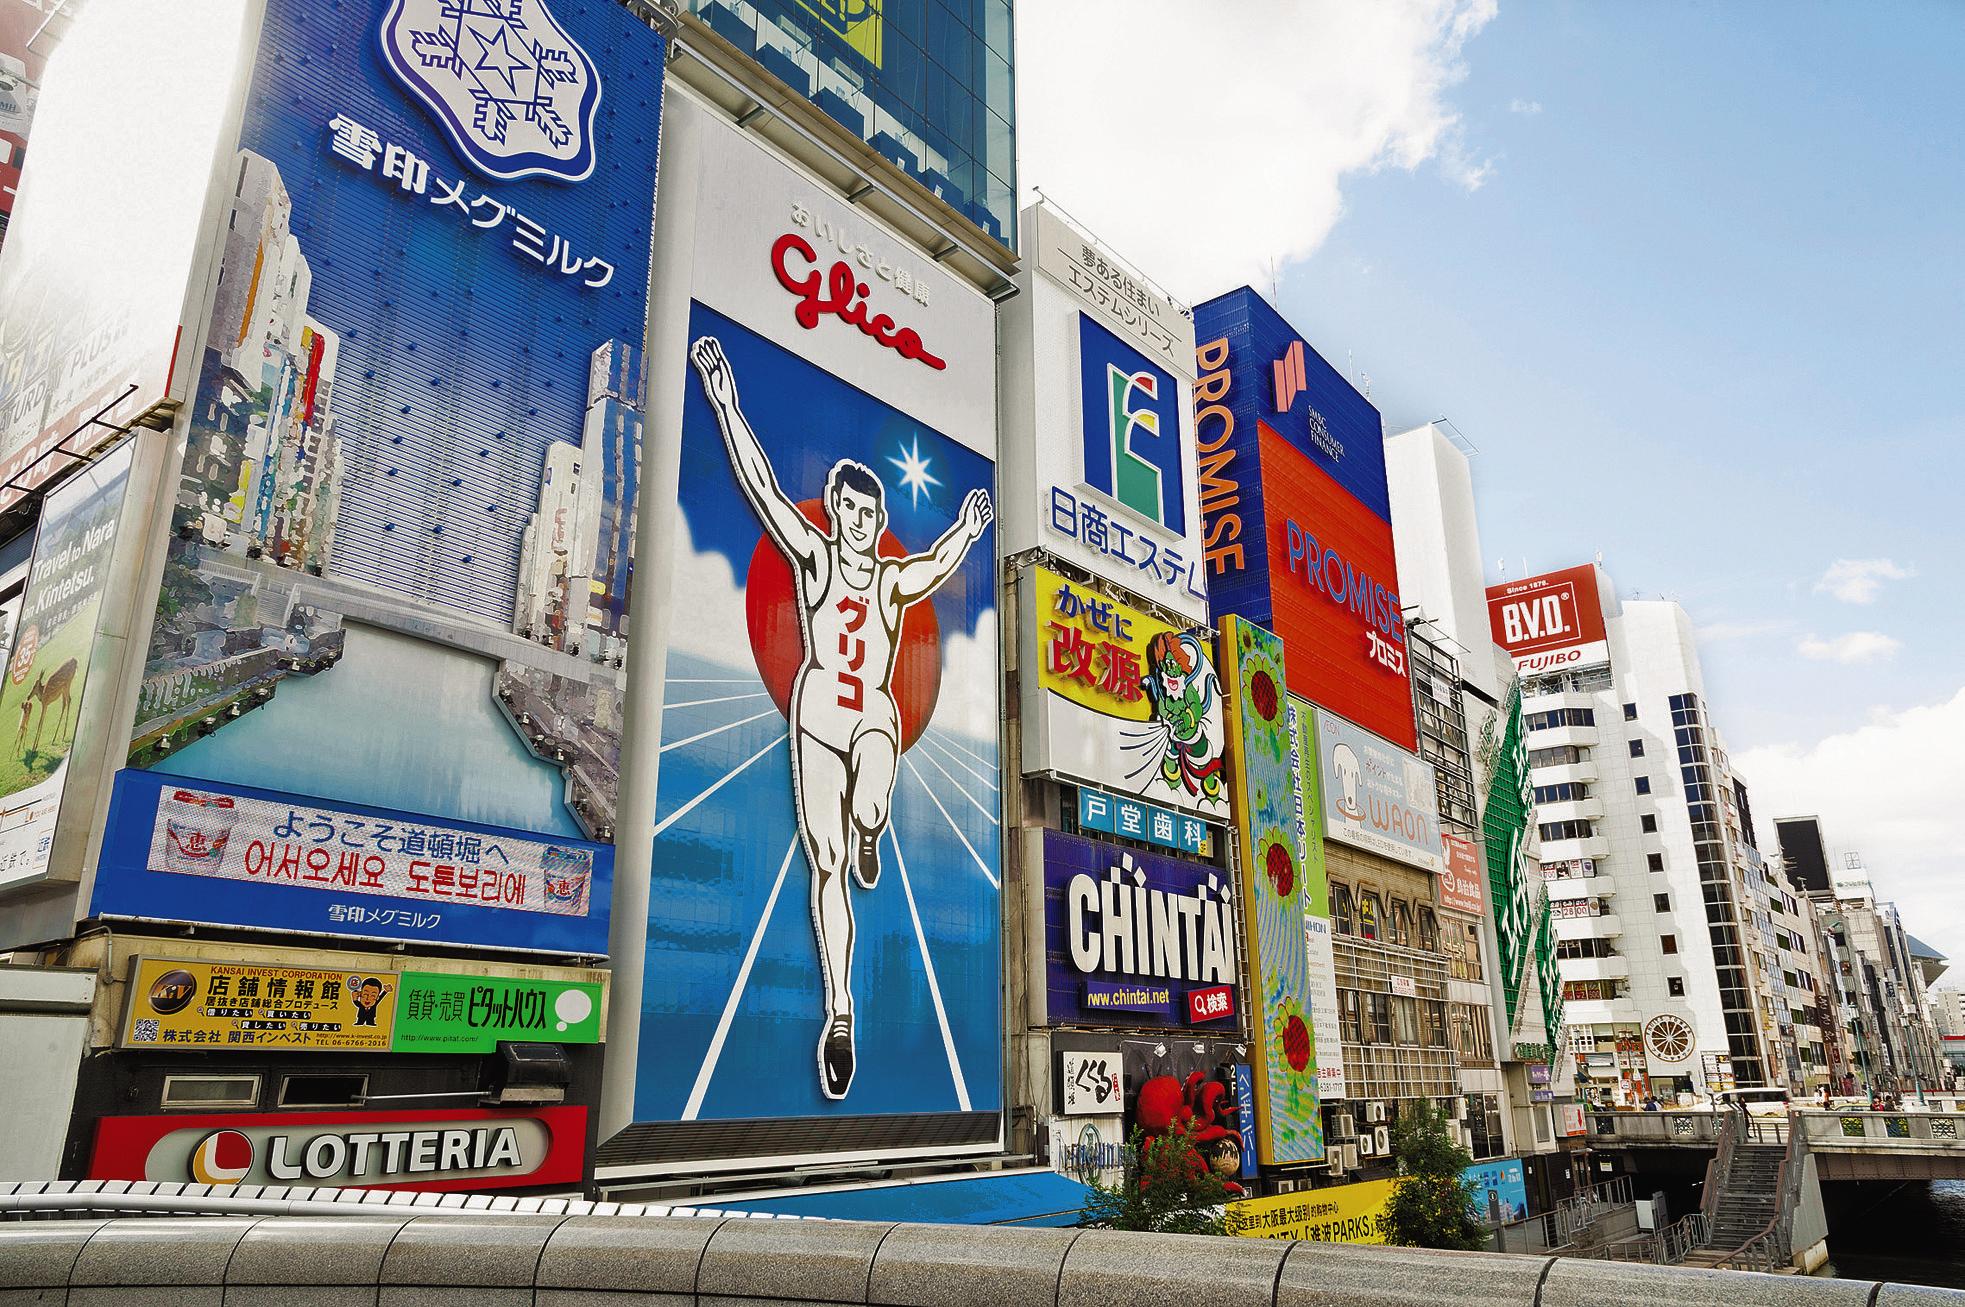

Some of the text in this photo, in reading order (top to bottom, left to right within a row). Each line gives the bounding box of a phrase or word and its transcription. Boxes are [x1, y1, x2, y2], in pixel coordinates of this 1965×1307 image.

[329, 113, 615, 288] 雪印メグミルク
[791, 202, 930, 308] おいしさと健康
[771, 233, 947, 371] Glico
[1081, 244, 1161, 317] 夢ある住まい
[1068, 265, 1176, 358] エステムシリーズ
[1308, 404, 1327, 429] SMBC
[1195, 337, 1245, 575] PROMISE
[1310, 429, 1340, 463] FINANCE
[33, 518, 115, 585] Travel to Nara
[35, 564, 95, 614] Kintetsu.
[1286, 518, 1403, 644] PROMISE
[1506, 585, 1528, 594] Since
[1057, 583, 1133, 642] かぜに
[1502, 593, 1571, 644] B.V.D.
[836, 595, 870, 713] グリコ
[1049, 620, 1144, 702] 改源
[1366, 630, 1407, 678] プロミス
[1517, 650, 1581, 671] FUJIBO
[272, 809, 510, 864] ようこそ道頓堀へ
[1087, 794, 1201, 847] 戸堂歯科
[1368, 793, 1428, 846] WAON
[244, 839, 526, 905] 어서오세요 도톤보리에
[328, 903, 441, 929] 雪印メグミルク
[207, 975, 342, 1000] 店舗情報館
[210, 965, 343, 981] KANSAI INVEST CORPORATION
[207, 1008, 253, 1017] 借りたい
[300, 1022, 341, 1031] 売りたい
[407, 989, 465, 1021] 賃貸・売買
[468, 986, 546, 1029] ピタットハウス
[1206, 992, 1228, 1013] 検索
[163, 1029, 311, 1044] 株式会社 関西インベスト
[1075, 1059, 1112, 1104] くくる
[1230, 1064, 1237, 1096] 2F
[268, 1127, 523, 1180] LOTTERIA
